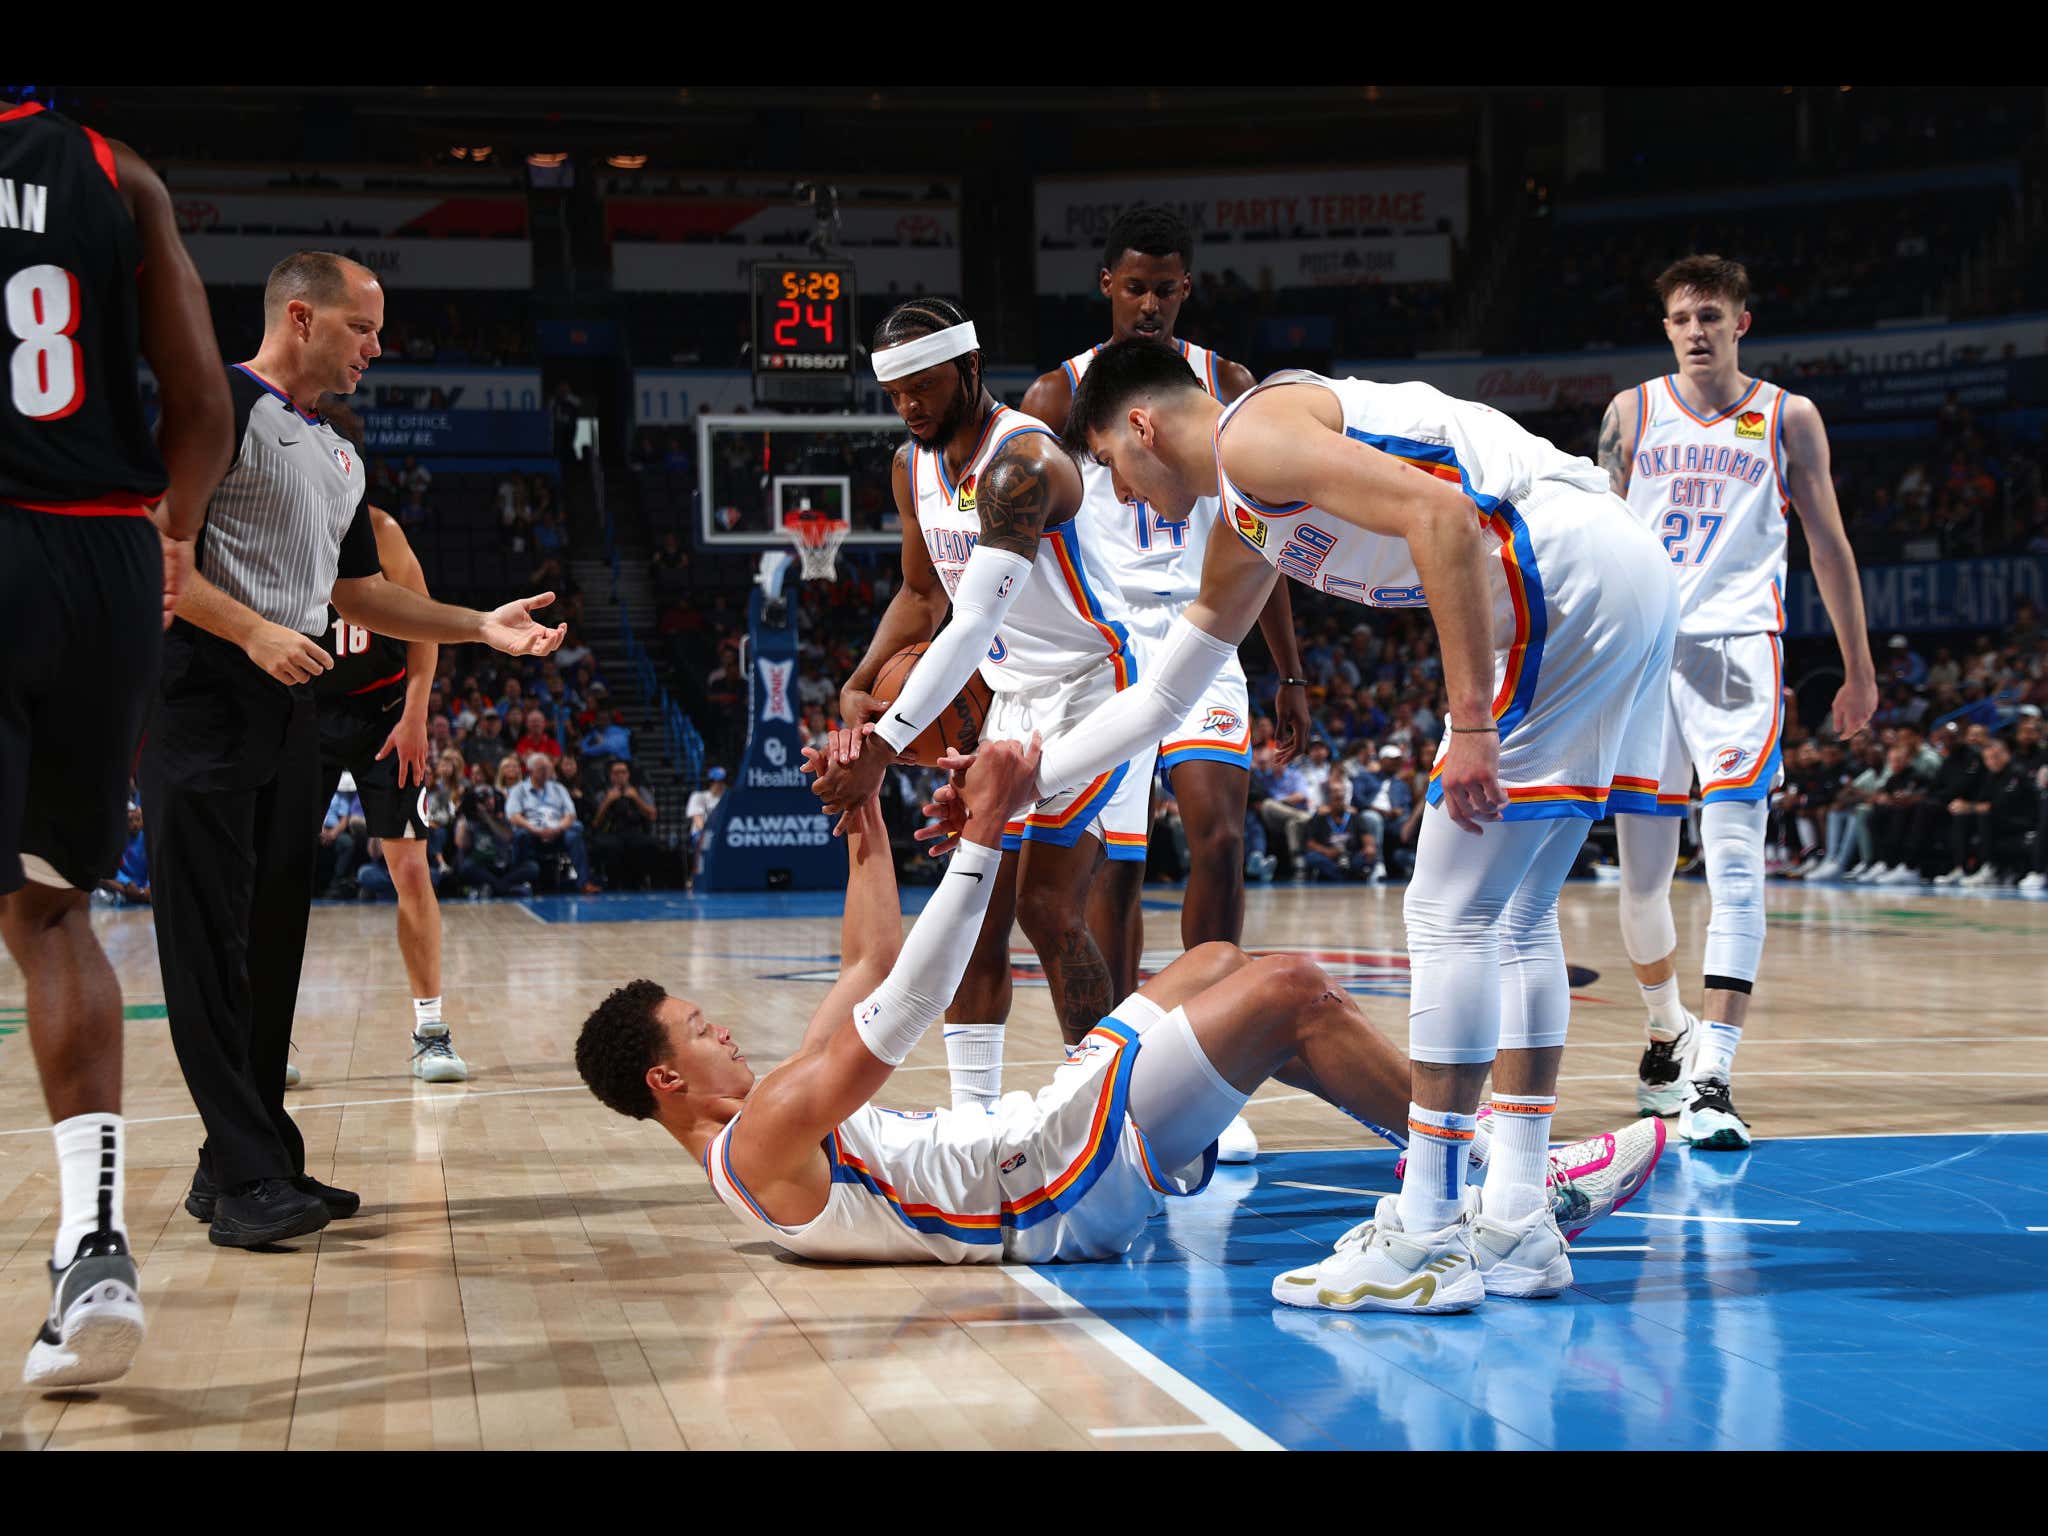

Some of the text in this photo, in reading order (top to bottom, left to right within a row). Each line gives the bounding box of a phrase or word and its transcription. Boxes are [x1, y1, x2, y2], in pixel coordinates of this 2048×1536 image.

[1216, 199, 1297, 229] PARTY
[1310, 191, 1425, 225] TERRACE
[781, 271, 840, 300] 5:29
[773, 299, 834, 347] 24
[4, 264, 87, 422] 8
[784, 354, 849, 369] TISSOT
[642, 391, 688, 418] 111
[367, 415, 393, 427] THE
[380, 432, 409, 446] MAY
[1638, 444, 1769, 488] OKLAHOMA
[1670, 477, 1727, 508] CITY
[1127, 498, 1190, 552] 14
[1660, 510, 1728, 567] 27
[1800, 556, 2043, 633] HMELAND
[770, 666, 785, 715] SONIC
[748, 767, 808, 788] Health
[726, 831, 831, 848] ONWARD
[727, 815, 830, 833] ALWAYS
